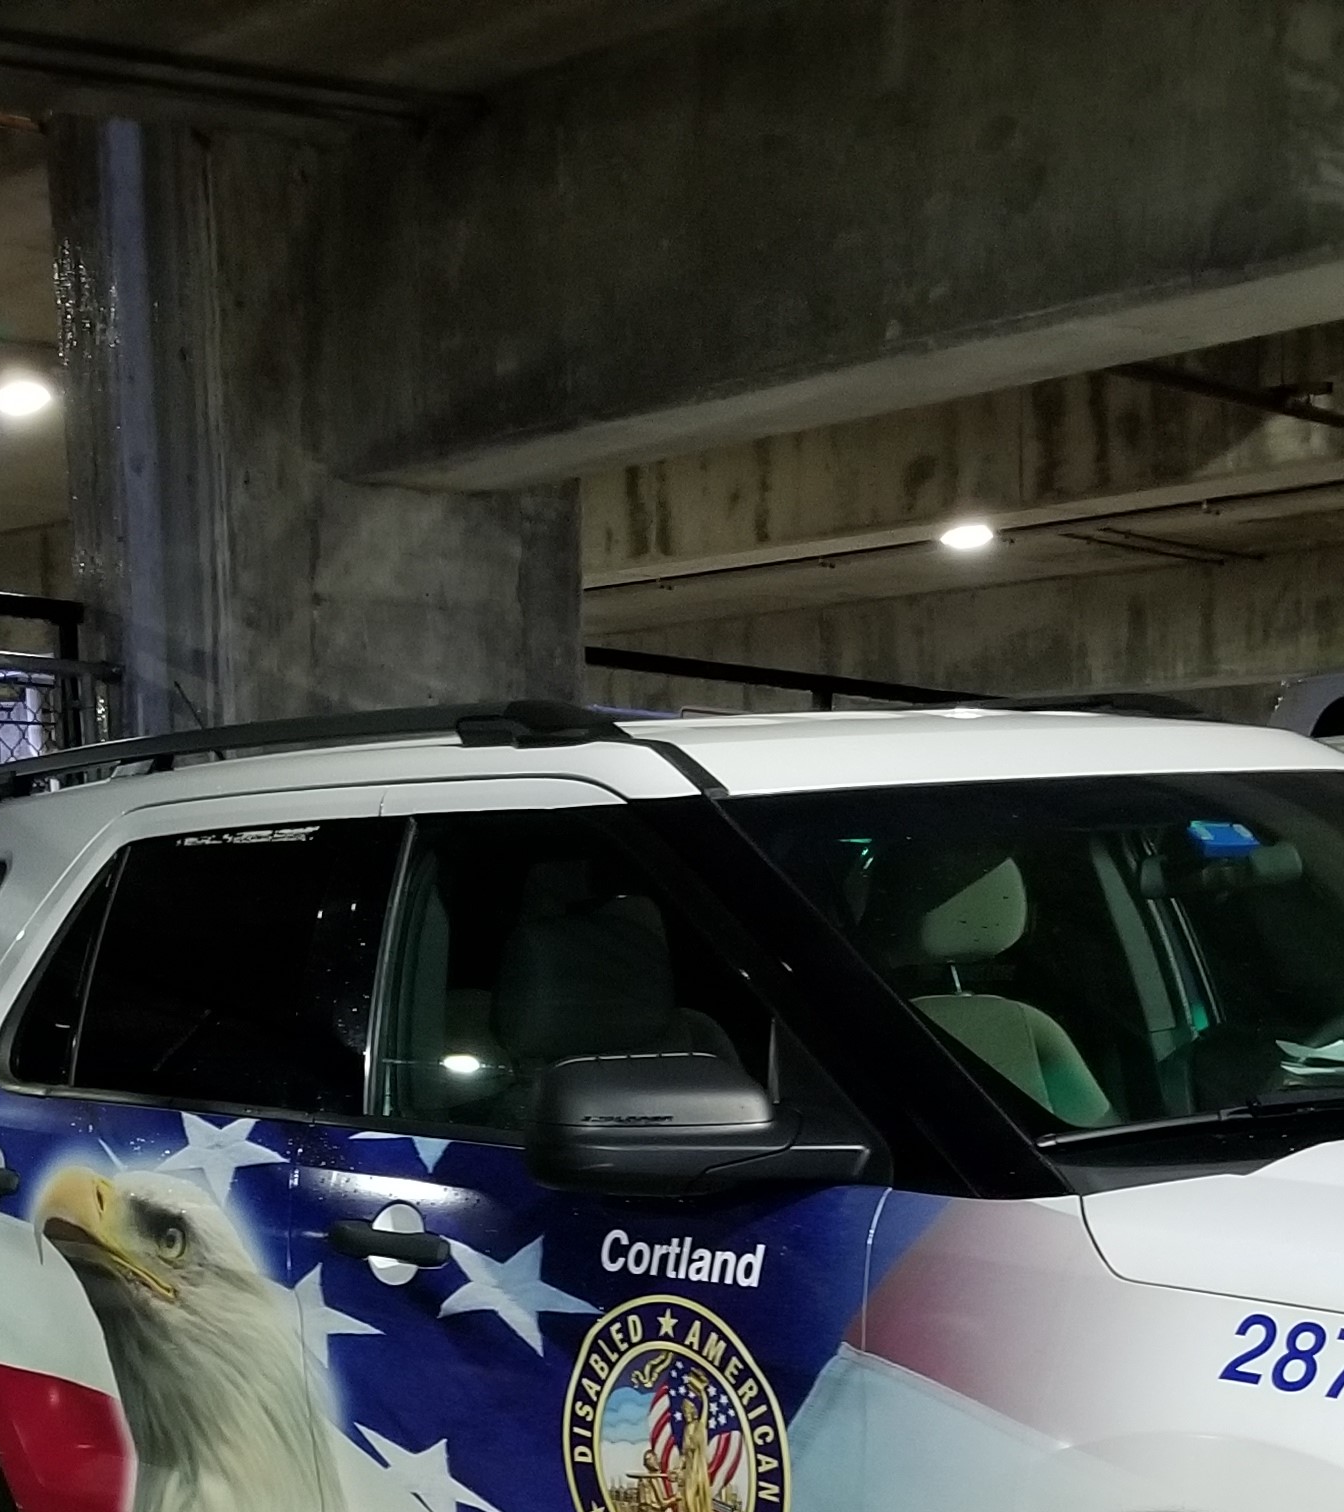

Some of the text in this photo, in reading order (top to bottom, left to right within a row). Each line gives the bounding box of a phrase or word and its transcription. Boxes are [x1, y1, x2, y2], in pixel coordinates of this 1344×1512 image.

[600, 1229, 766, 1288] Cortland
[573, 1313, 780, 1504] DISABLED AMERICAN
